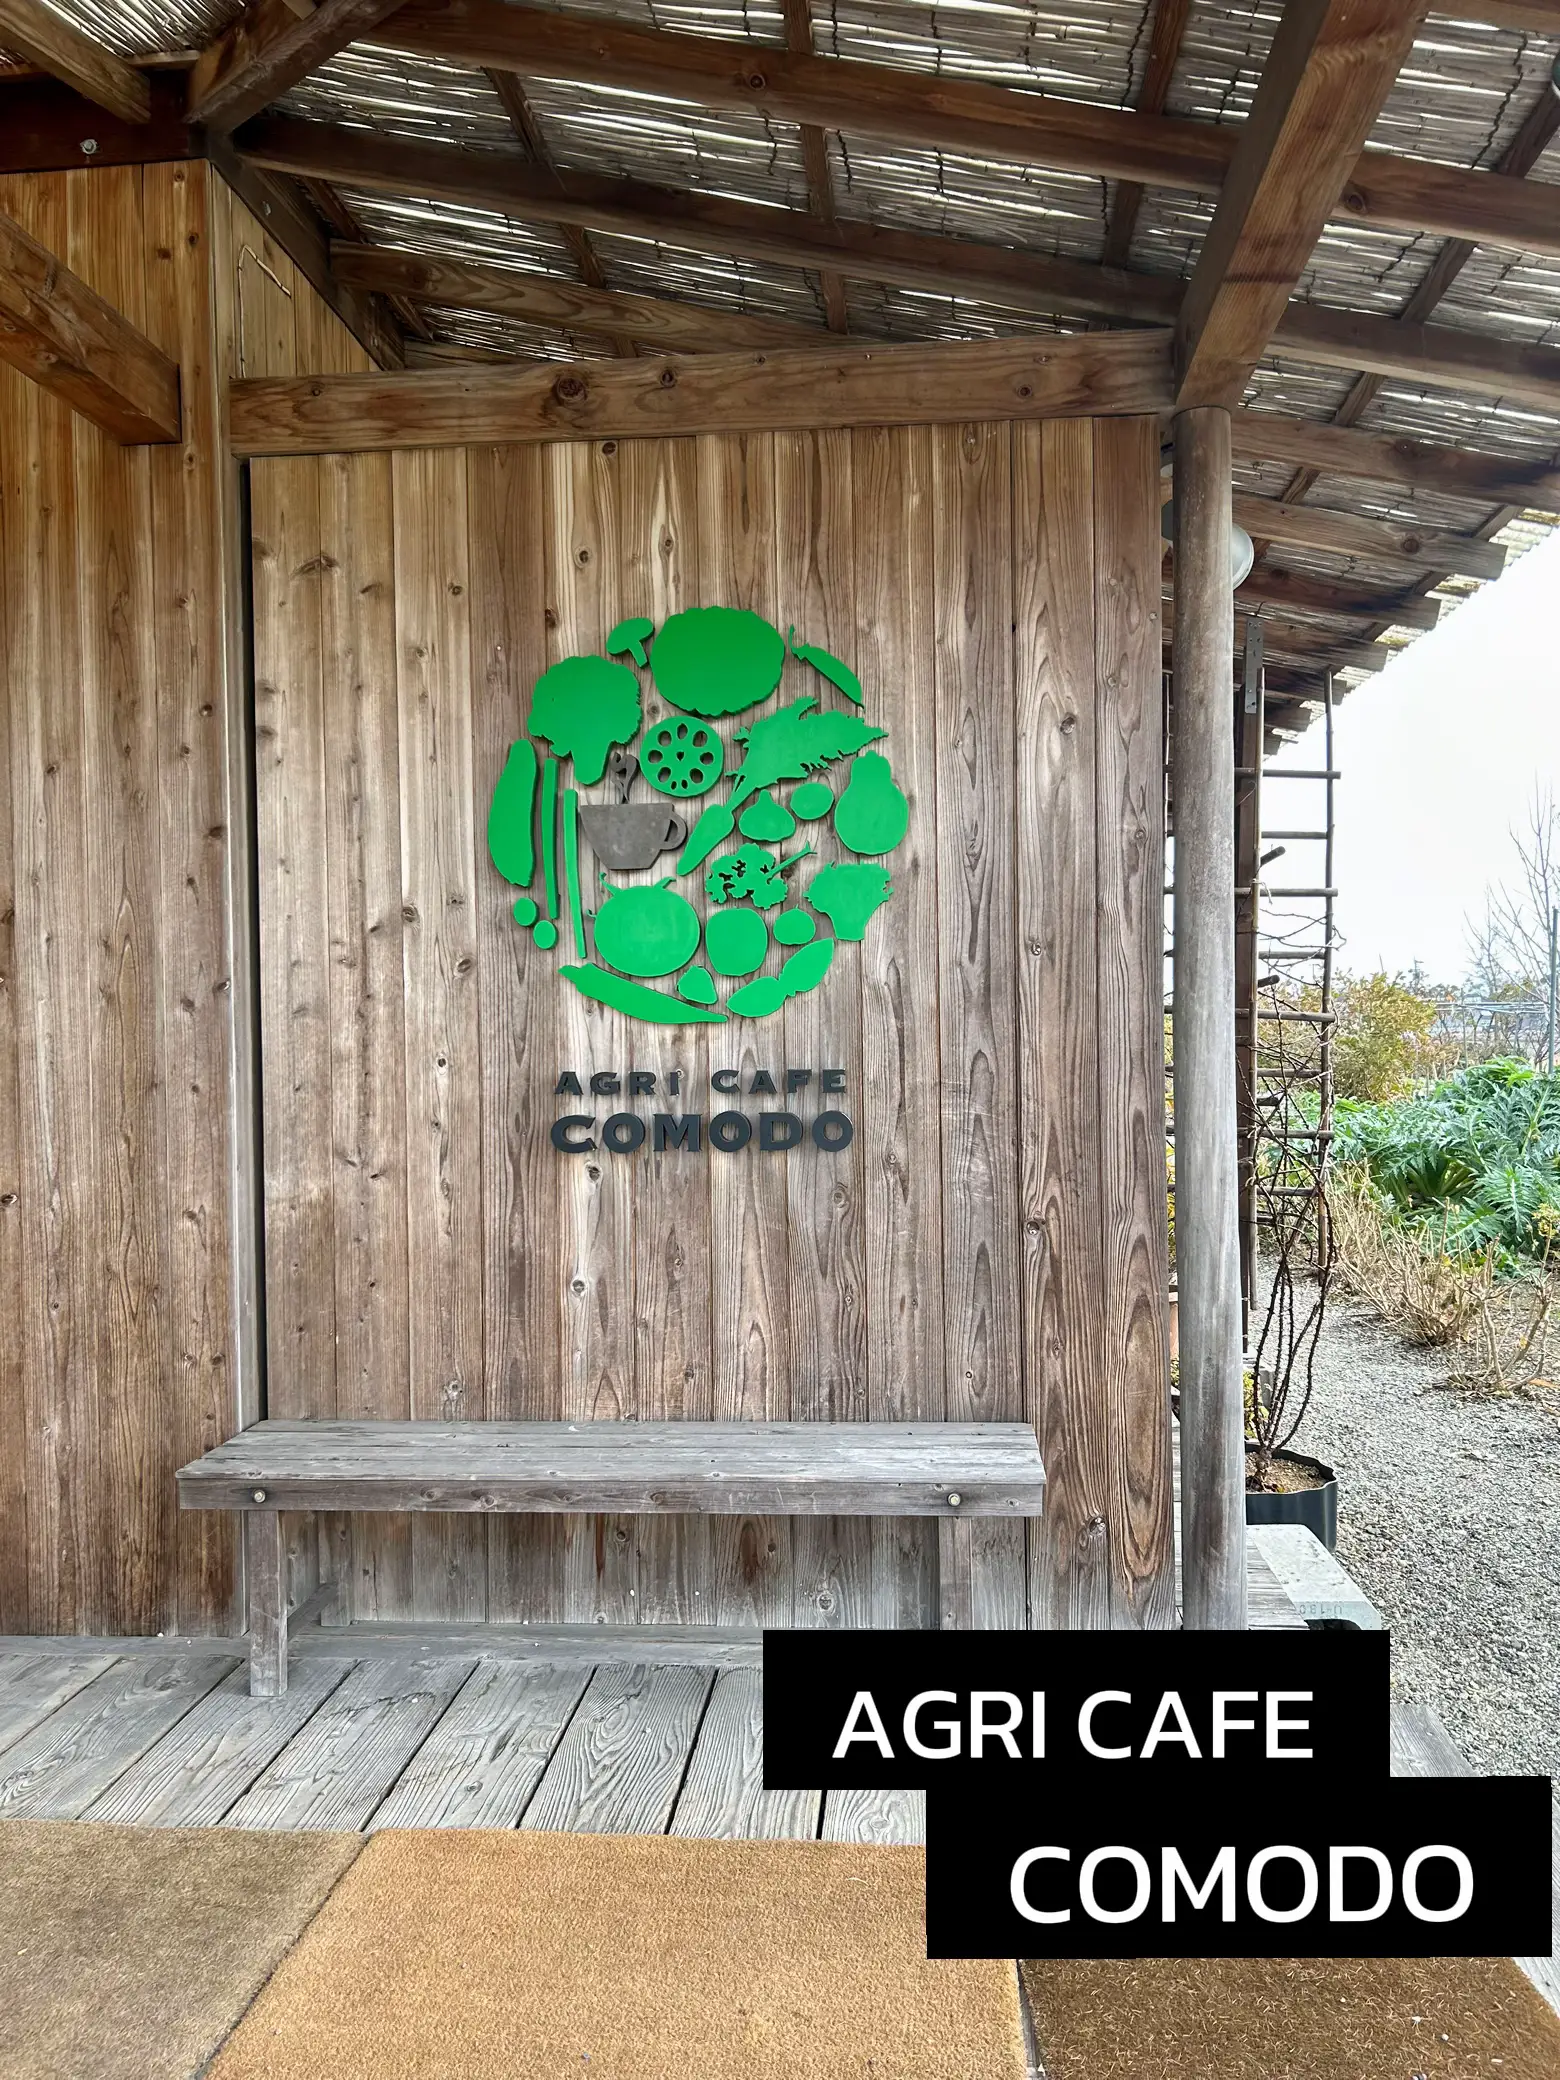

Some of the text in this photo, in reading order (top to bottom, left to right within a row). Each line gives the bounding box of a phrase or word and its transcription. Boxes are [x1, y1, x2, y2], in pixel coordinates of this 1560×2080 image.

[554, 1069, 846, 1096] AGRI CAFE
[550, 1110, 854, 1153] COMODO
